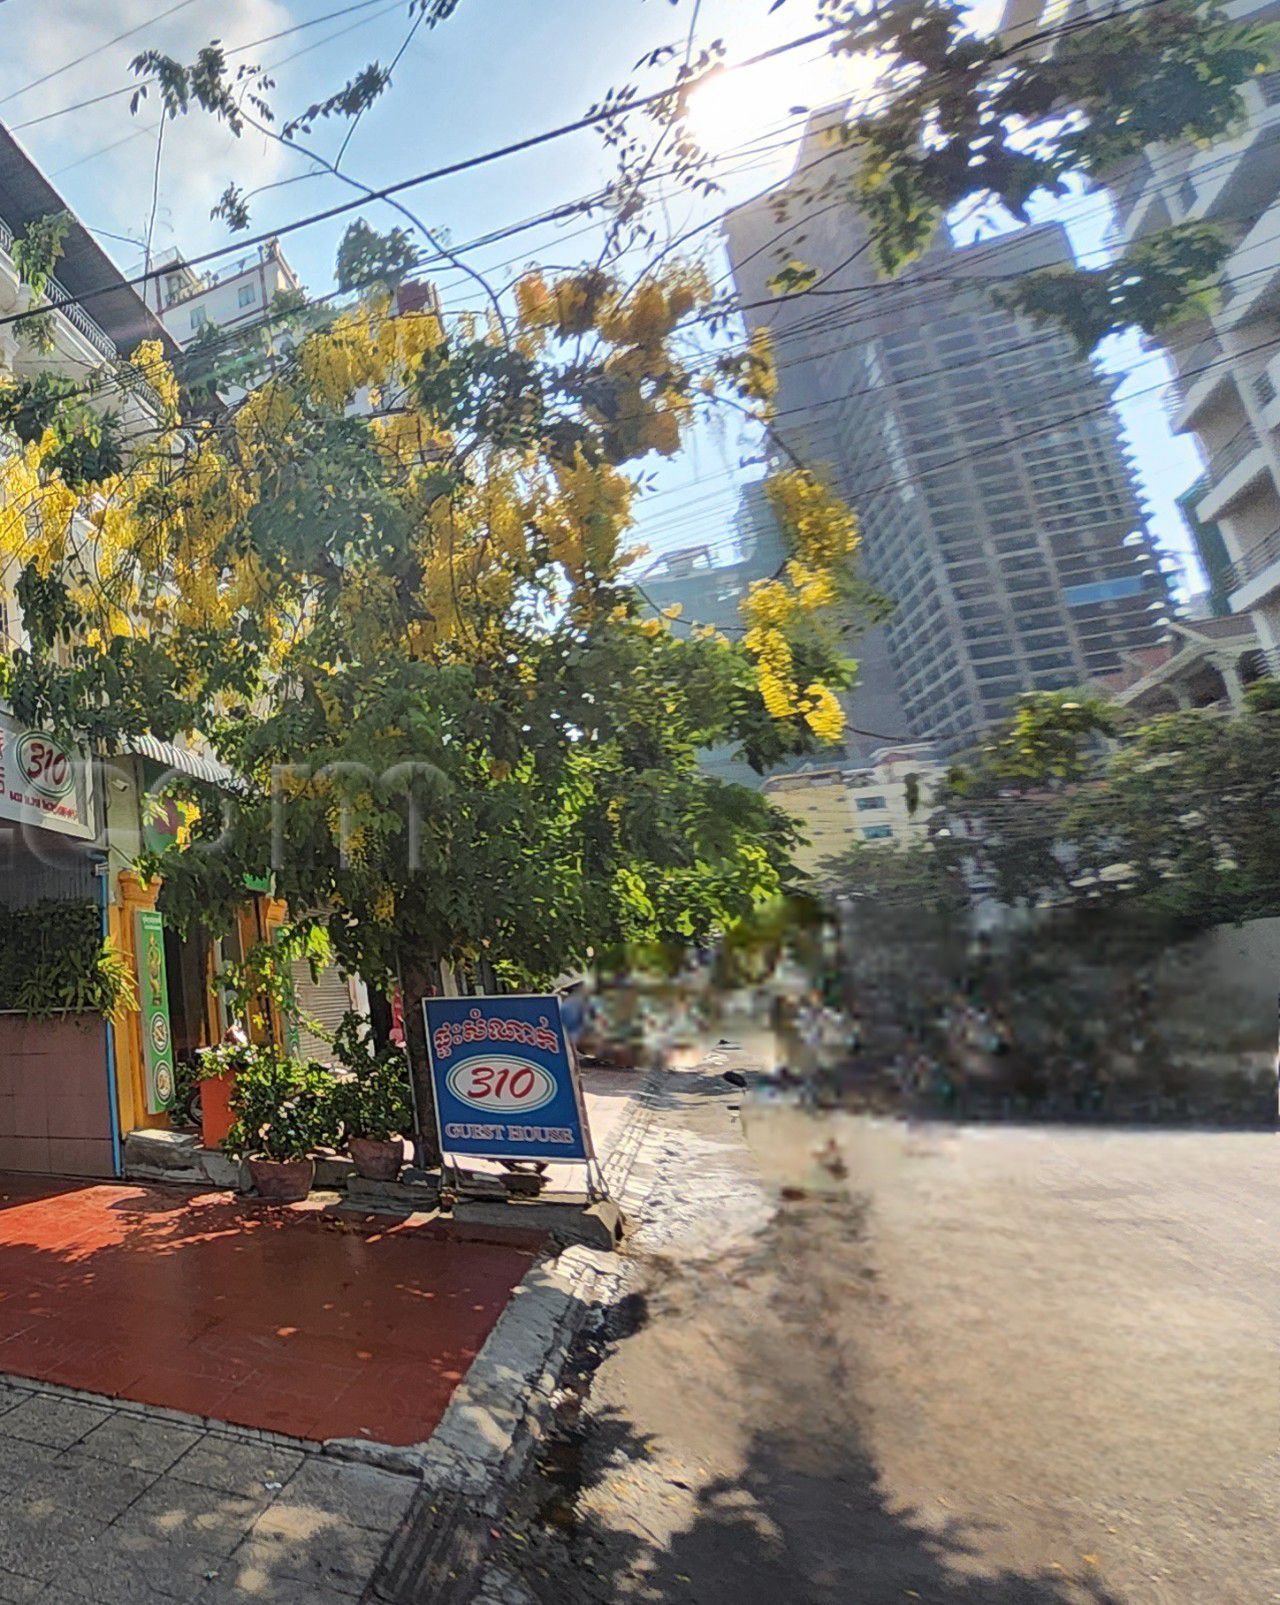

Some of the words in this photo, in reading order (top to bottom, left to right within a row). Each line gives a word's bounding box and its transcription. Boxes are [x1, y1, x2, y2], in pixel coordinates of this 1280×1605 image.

[26, 741, 67, 786] 310
[466, 1065, 536, 1099] 310
[444, 1122, 505, 1142] GUEST
[506, 1124, 575, 1144] HOUSE
